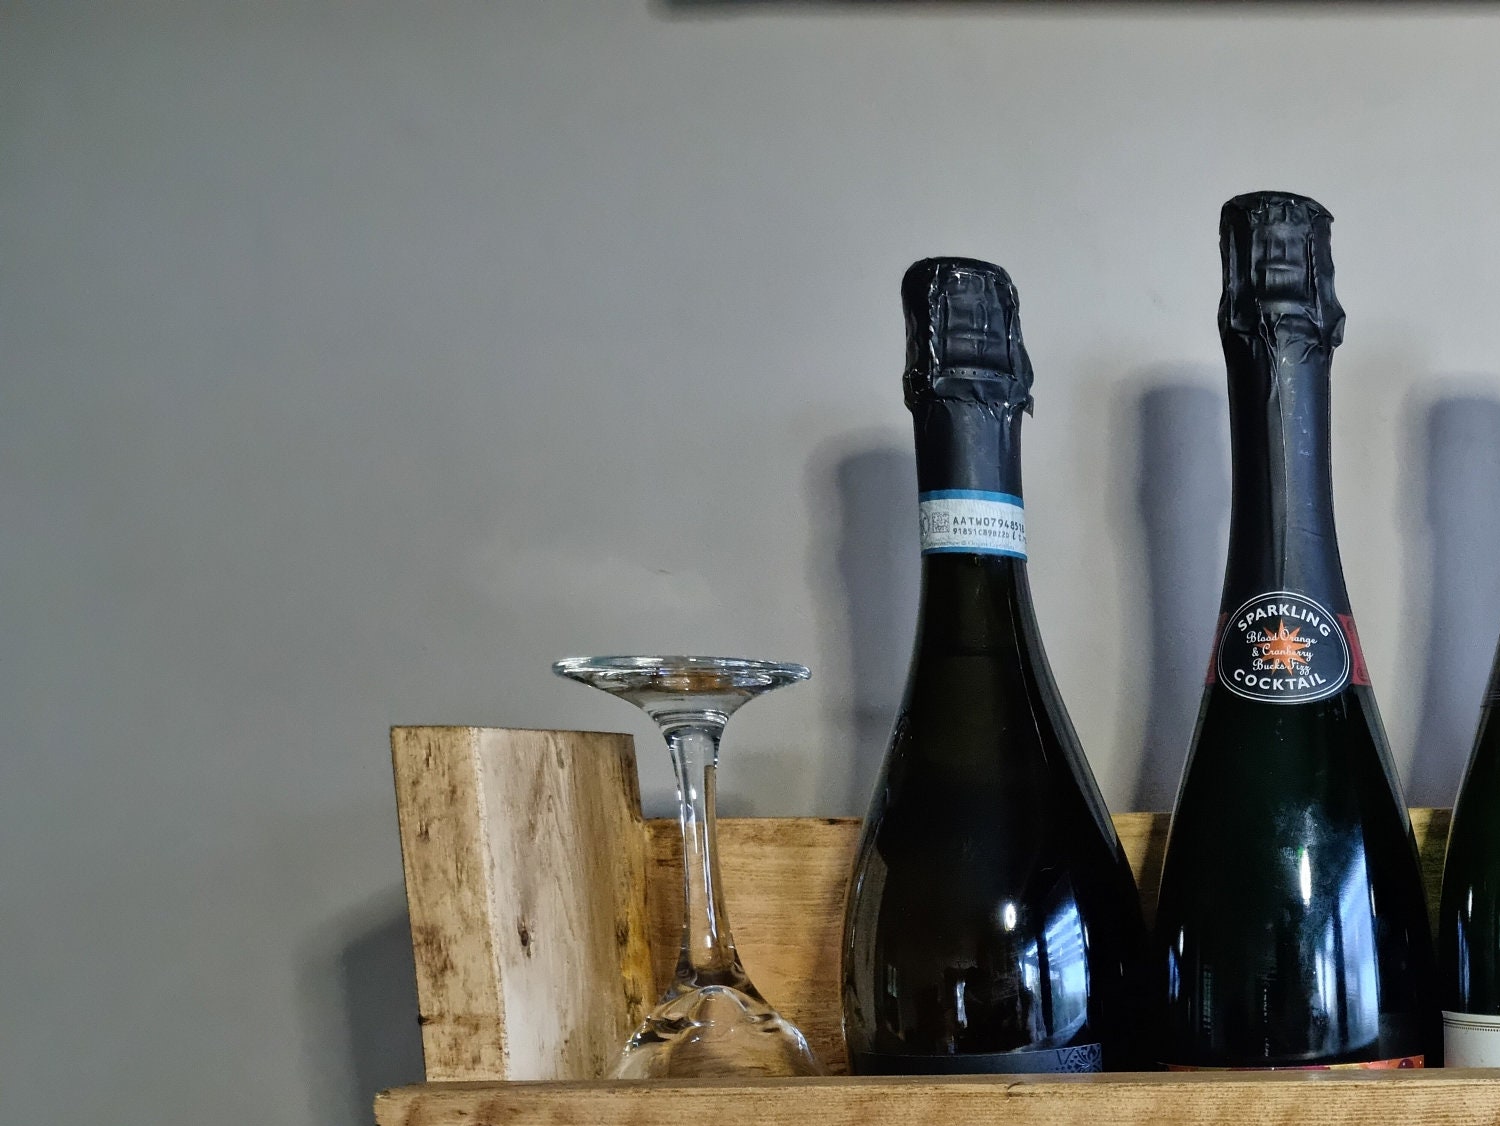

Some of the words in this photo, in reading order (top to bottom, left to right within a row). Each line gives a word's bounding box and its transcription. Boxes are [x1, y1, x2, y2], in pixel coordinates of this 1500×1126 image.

[1237, 603, 1331, 637] SPARKLING
[1246, 630, 1278, 644] Blood
[1280, 626, 1318, 648] Orange
[1252, 647, 1259, 657] &
[1262, 643, 1314, 662] Cranberry
[1252, 657, 1286, 671] Bucks
[1287, 657, 1312, 675] Fizz
[1233, 668, 1327, 691] COCKTAIL
